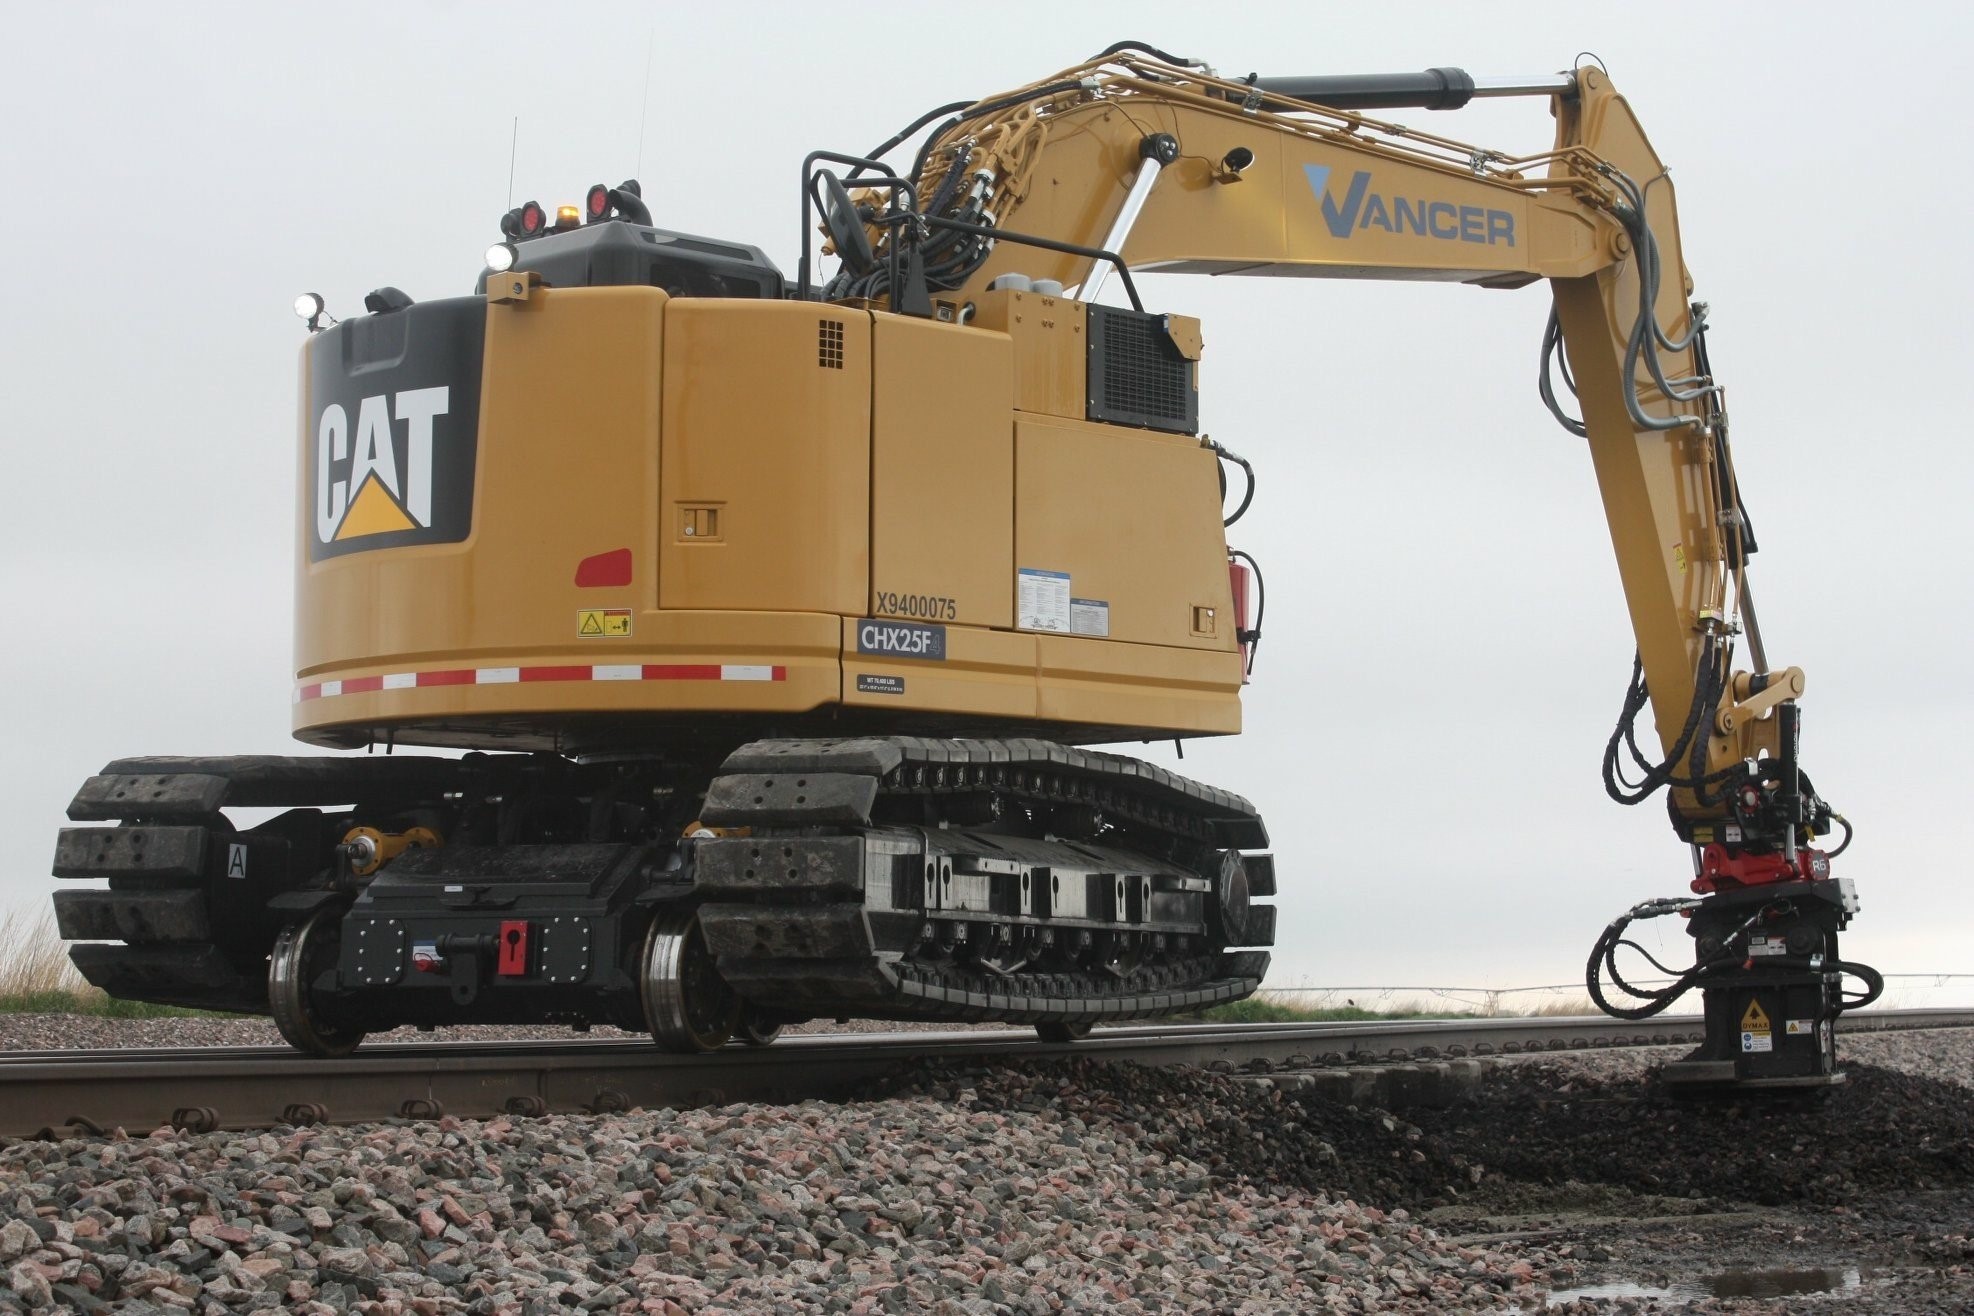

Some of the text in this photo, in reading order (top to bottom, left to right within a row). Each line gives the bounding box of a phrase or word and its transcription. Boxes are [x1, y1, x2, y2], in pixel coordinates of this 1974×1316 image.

[1303, 164, 1515, 247] VANCER
[317, 386, 449, 544] CAT
[877, 592, 956, 620] X9400075
[229, 846, 244, 876] A
